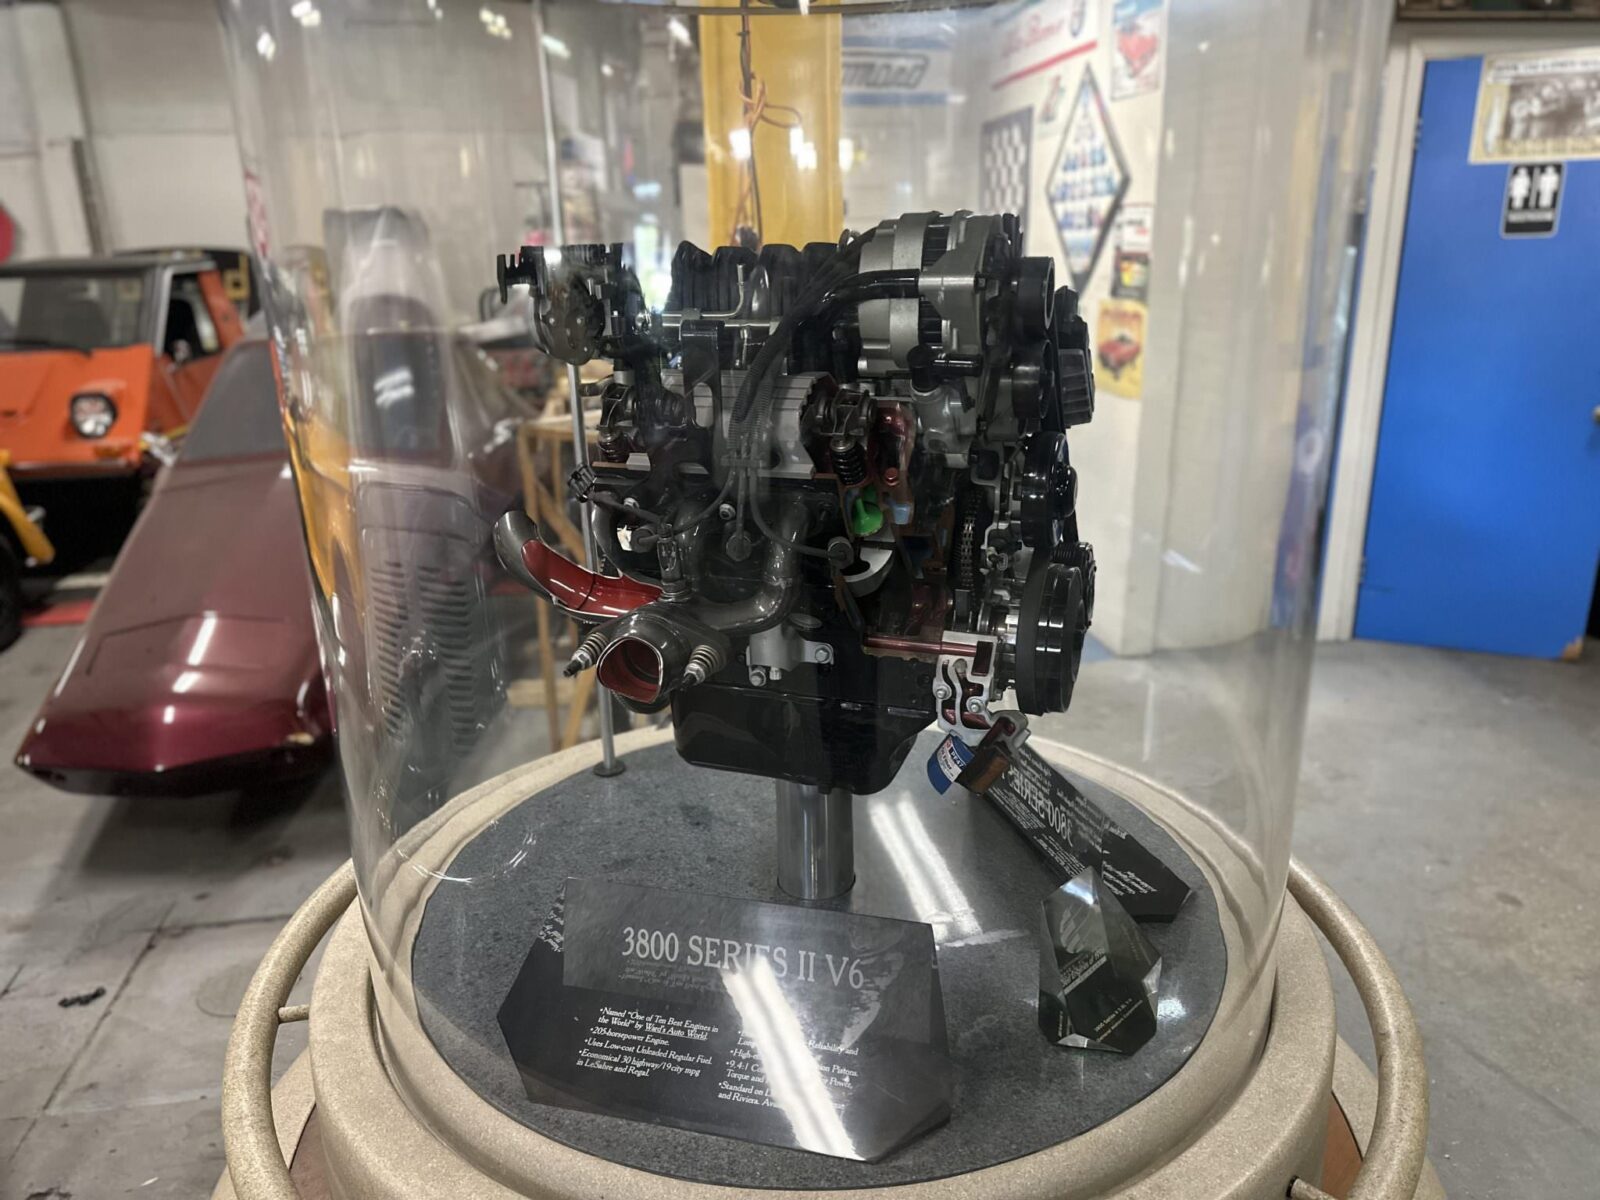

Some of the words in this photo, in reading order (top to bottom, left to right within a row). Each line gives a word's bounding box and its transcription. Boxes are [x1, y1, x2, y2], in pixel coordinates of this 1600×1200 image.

[622, 926, 679, 962] 3800
[797, 950, 816, 982] II
[825, 953, 864, 989] V6
[598, 1016, 609, 1024] the
[635, 1020, 643, 1030] by
[666, 1026, 685, 1037] Auto
[602, 1007, 626, 1018] Named
[645, 1013, 654, 1021] of
[655, 1015, 667, 1024] Ten
[667, 1017, 684, 1026] Best
[684, 1020, 711, 1032] Engines
[711, 1025, 719, 1033] in
[592, 1026, 644, 1041] 205-horsepower
[587, 1037, 603, 1048] Uses
[604, 1041, 635, 1053] Low-cost
[636, 1045, 668, 1058] Unleaded
[668, 1051, 695, 1063] Regular
[808, 1039, 843, 1054] Reliability
[845, 1047, 859, 1055] and
[576, 1058, 584, 1066] in
[584, 1058, 613, 1071] LeSabre
[613, 1064, 627, 1073] and
[581, 1049, 622, 1063] Economical
[621, 1055, 632, 1064] 30
[684, 1067, 701, 1077] mpg
[729, 1060, 748, 1071] 9.4:1
[727, 1068, 750, 1082] Torque
[750, 1075, 765, 1084] and
[721, 1080, 753, 1094] Standard
[718, 1092, 731, 1101] and
